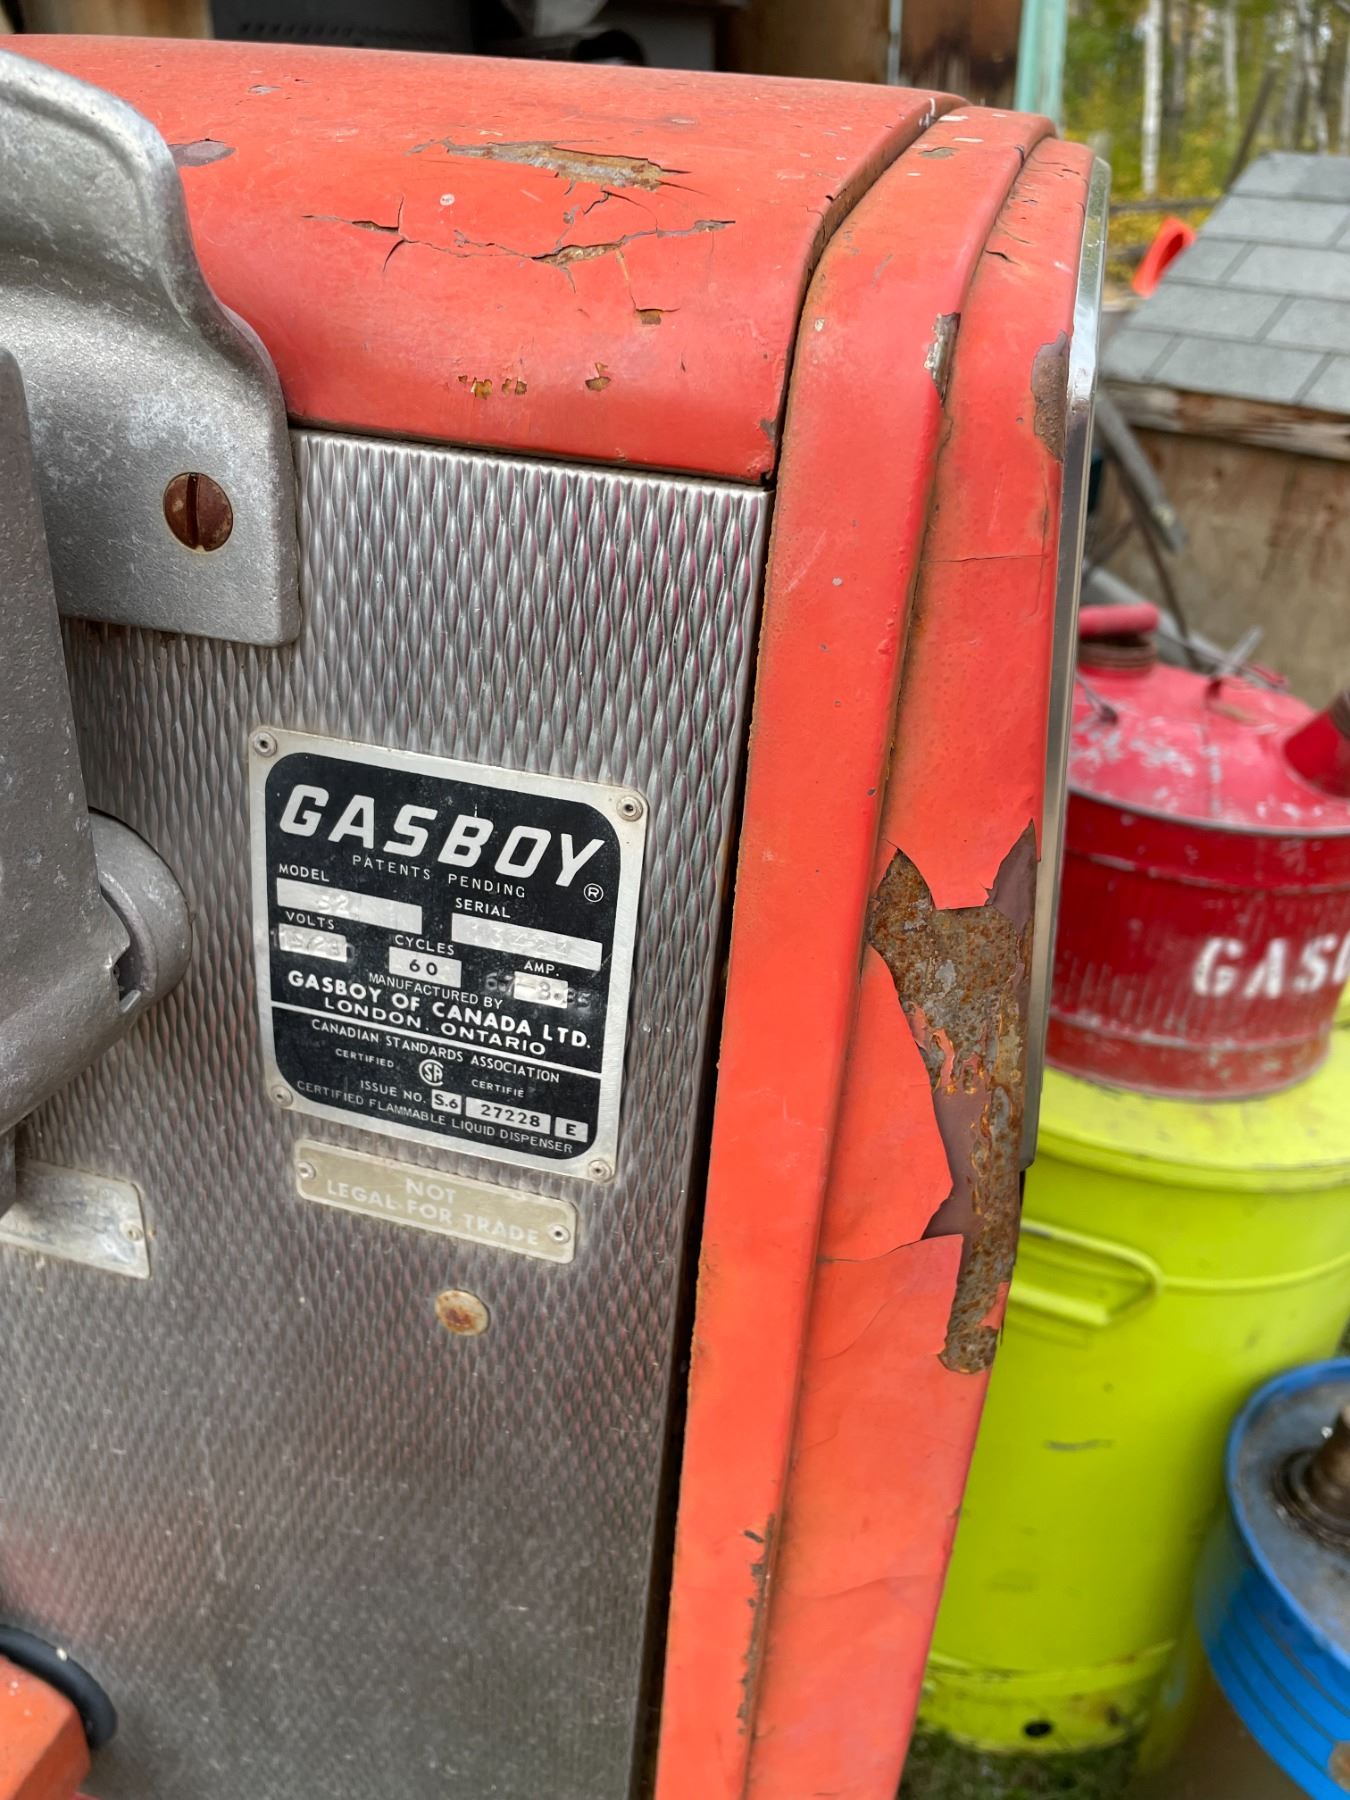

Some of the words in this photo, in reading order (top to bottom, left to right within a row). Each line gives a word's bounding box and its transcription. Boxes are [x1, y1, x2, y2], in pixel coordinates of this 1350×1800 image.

[279, 783, 605, 888] GASBOY
[279, 863, 330, 882] MODEL
[352, 854, 431, 880] PATENTS
[448, 873, 526, 899] PENDING
[285, 911, 335, 930] VOLTS
[455, 897, 511, 919] SERIAL
[394, 934, 455, 956] CYCLES
[409, 958, 438, 976] 60
[523, 960, 560, 977] AMP.
[369, 972, 479, 1006] MANUFACTURED
[483, 996, 503, 1010] BY
[288, 970, 382, 1004] GASBOY
[391, 993, 421, 1012] OF
[432, 1001, 532, 1037] CANADA
[543, 1024, 591, 1049] LTD.
[311, 1019, 379, 1043] CANADIAN
[385, 1035, 464, 1063] STANDARDS
[470, 1054, 560, 1084] ASSOCIATION
[440, 1022, 546, 1056] ONTARIO
[335, 1048, 395, 1068] CERTIFIED
[297, 1080, 364, 1106] CERTIFIED
[368, 1098, 447, 1126] FLAMMABLE
[451, 1118, 496, 1138] LIQUID
[500, 1129, 573, 1154] DISPENSER
[360, 1080, 398, 1097] ISSUE
[403, 1090, 426, 1104] NO.
[481, 1103, 541, 1128] 27228
[565, 1123, 577, 1137] E
[405, 1178, 457, 1204] NOT
[327, 1179, 397, 1210] LEGAL
[407, 1200, 452, 1224] FOR
[463, 1213, 539, 1246] TRADE
